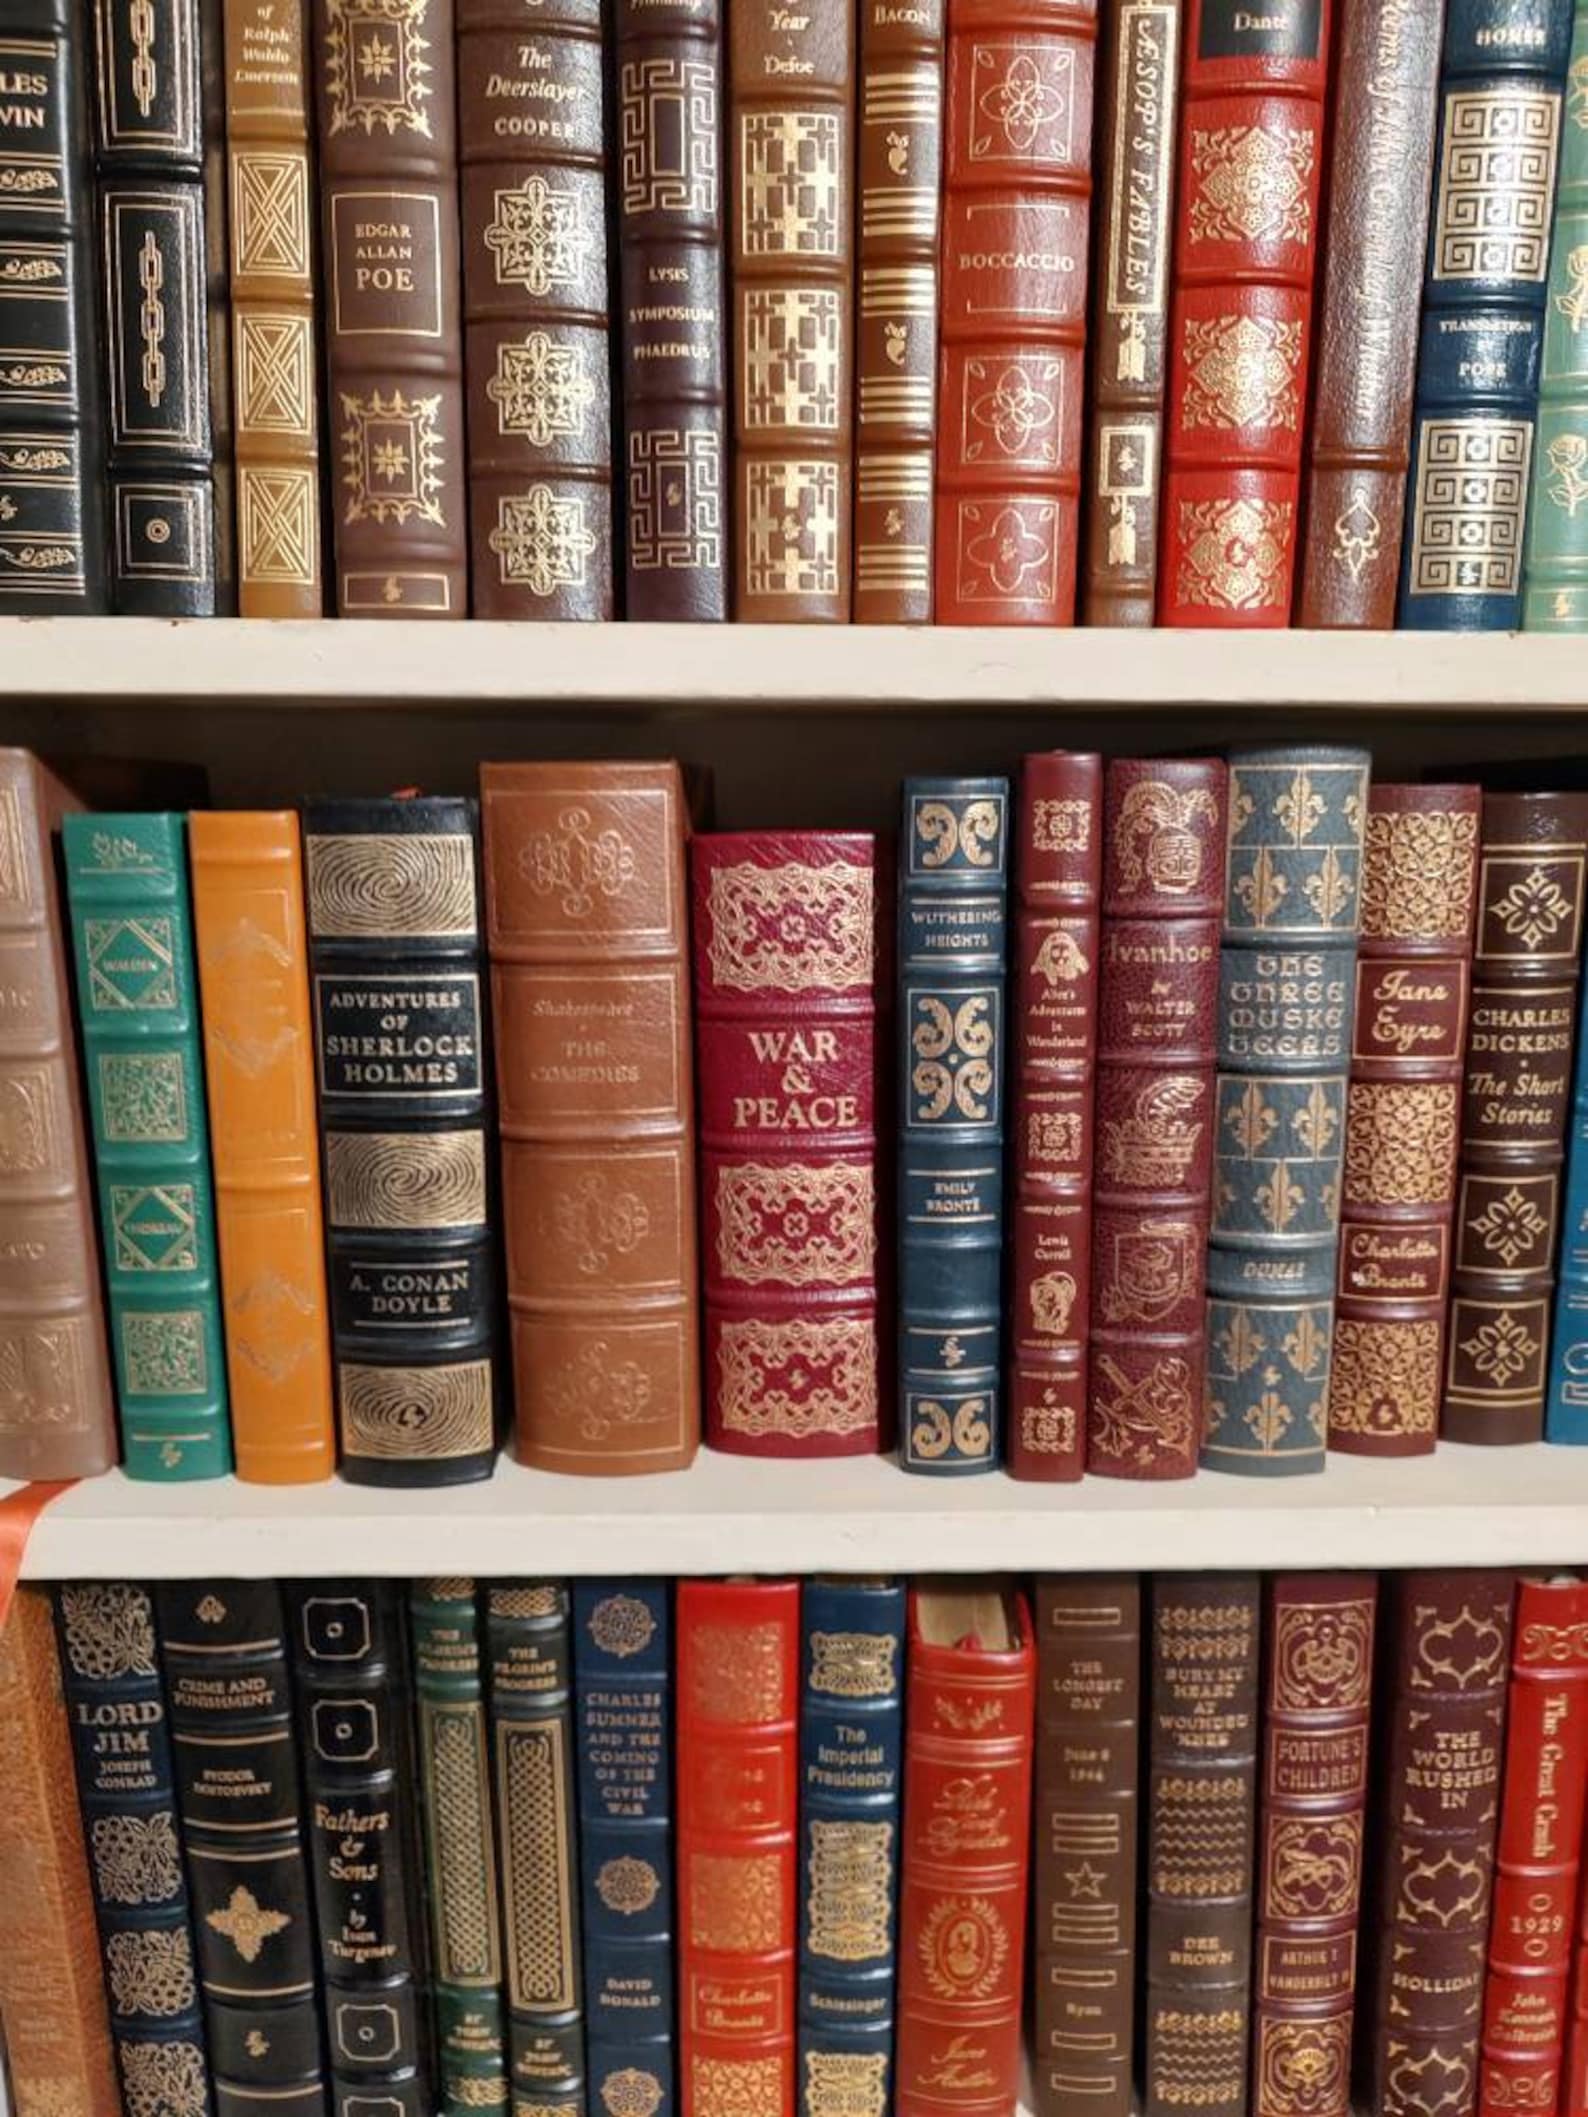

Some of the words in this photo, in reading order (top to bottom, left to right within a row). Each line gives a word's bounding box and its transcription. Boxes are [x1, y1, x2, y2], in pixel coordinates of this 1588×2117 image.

[256, 4, 276, 20] of
[769, 9, 811, 31] Year
[243, 26, 290, 45] Ralph
[518, 44, 553, 69] The
[763, 55, 815, 75] Defoe
[493, 116, 578, 138] COOPER
[355, 223, 412, 239] EDGAR
[1126, 168, 1154, 296] FABLES
[355, 245, 412, 260] ALLAN
[959, 252, 1075, 273] BOCCACCIO
[355, 267, 415, 292] POE
[648, 266, 690, 283] LYSIS
[629, 305, 716, 323] SYMPOSIUM
[911, 910, 1003, 925] WUTHERING
[1110, 933, 1214, 963] Ivanhoe
[1373, 969, 1449, 1001] Jane
[329, 991, 462, 1009] ADVENTURES
[1125, 1000, 1196, 1015] WALTER
[380, 1014, 408, 1031] OF
[1472, 1008, 1571, 1028] CHARLES
[1131, 1022, 1187, 1037] SCOTT
[1371, 1005, 1448, 1054] Eyre
[326, 1034, 474, 1058] SHERLOCK
[748, 1030, 840, 1064] WAR
[1471, 1033, 1570, 1053] DICKENS
[343, 1062, 459, 1083] HOLMES
[781, 1064, 816, 1094] &
[1467, 1073, 1508, 1096] The
[1513, 1073, 1565, 1097] Short
[733, 1096, 860, 1129] PEACE
[1480, 1102, 1554, 1125] Stories
[349, 1274, 371, 1291] A.
[381, 1271, 468, 1293] CONAN
[371, 1294, 453, 1314] DOYLE
[228, 1677, 268, 1694] AND
[79, 1700, 164, 1726] LORD
[1543, 1693, 1568, 1736] The
[93, 1730, 150, 1753] JIM
[834, 1724, 867, 1743] The
[1435, 1731, 1481, 1750] THE
[817, 1744, 885, 1767] Imperial
[1412, 1748, 1496, 1770] WORLD
[94, 1774, 158, 1790] CONRAD
[1405, 1766, 1498, 1790] RUSHED
[1538, 1743, 1564, 1799] Great
[1441, 1791, 1470, 1809] IN
[314, 1802, 391, 1833] Fathers
[329, 1856, 379, 1881] Sons
[1508, 1914, 1565, 1935] 1929
